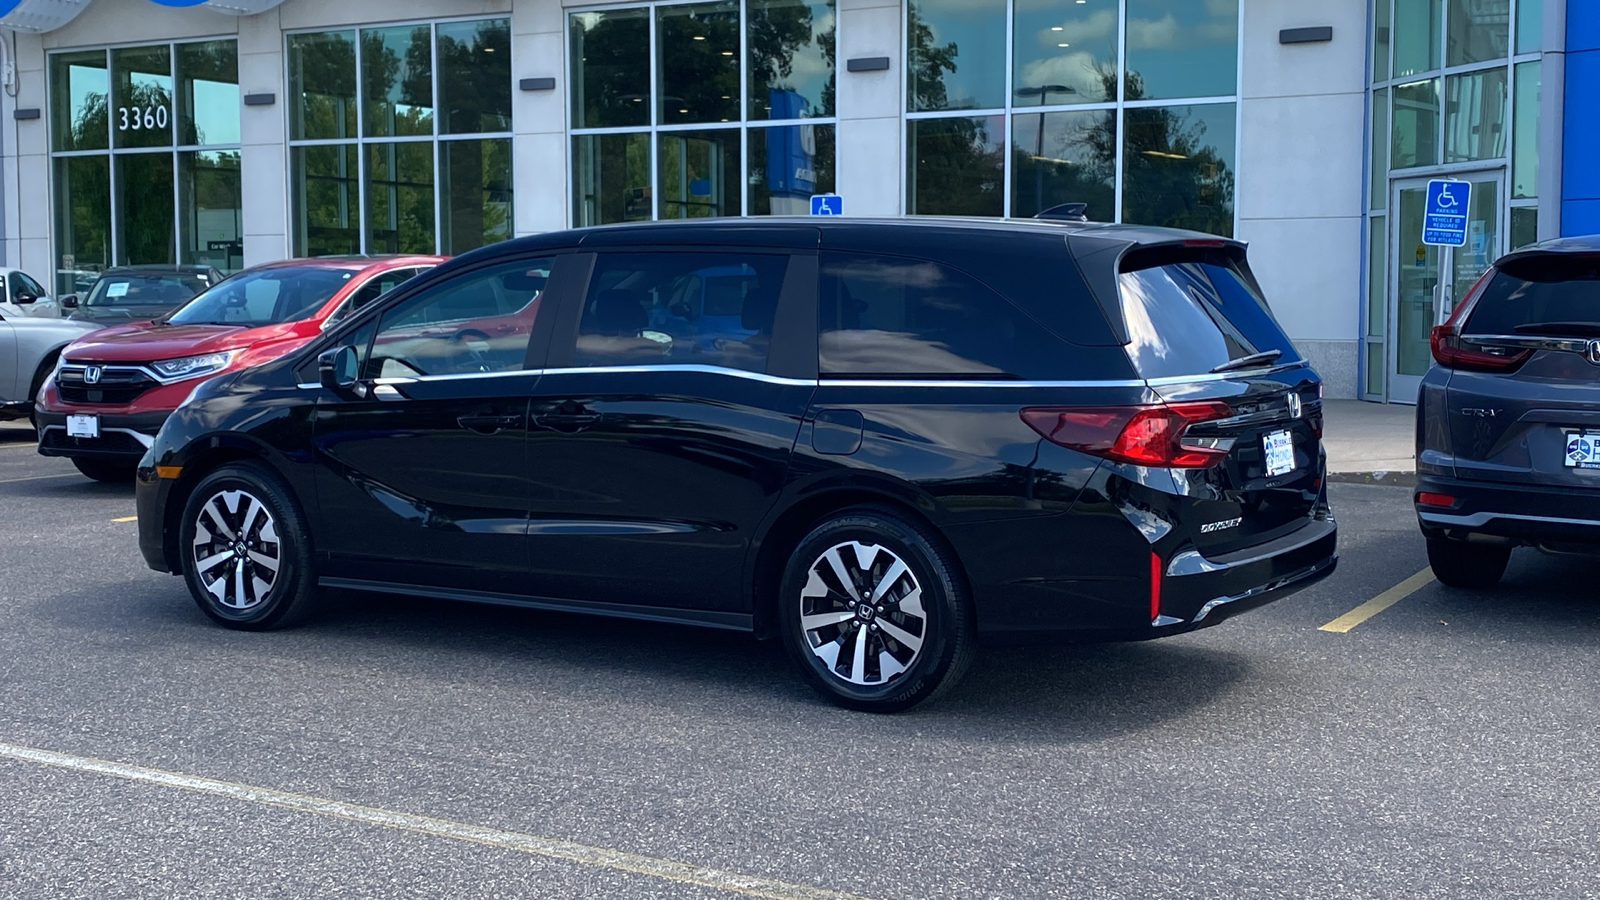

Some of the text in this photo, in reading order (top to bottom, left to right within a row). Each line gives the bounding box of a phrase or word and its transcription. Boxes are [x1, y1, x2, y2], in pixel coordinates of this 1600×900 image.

[118, 105, 167, 130] 3360
[1461, 407, 1503, 417] CR-V
[1200, 516, 1242, 534] ODYSSEY
